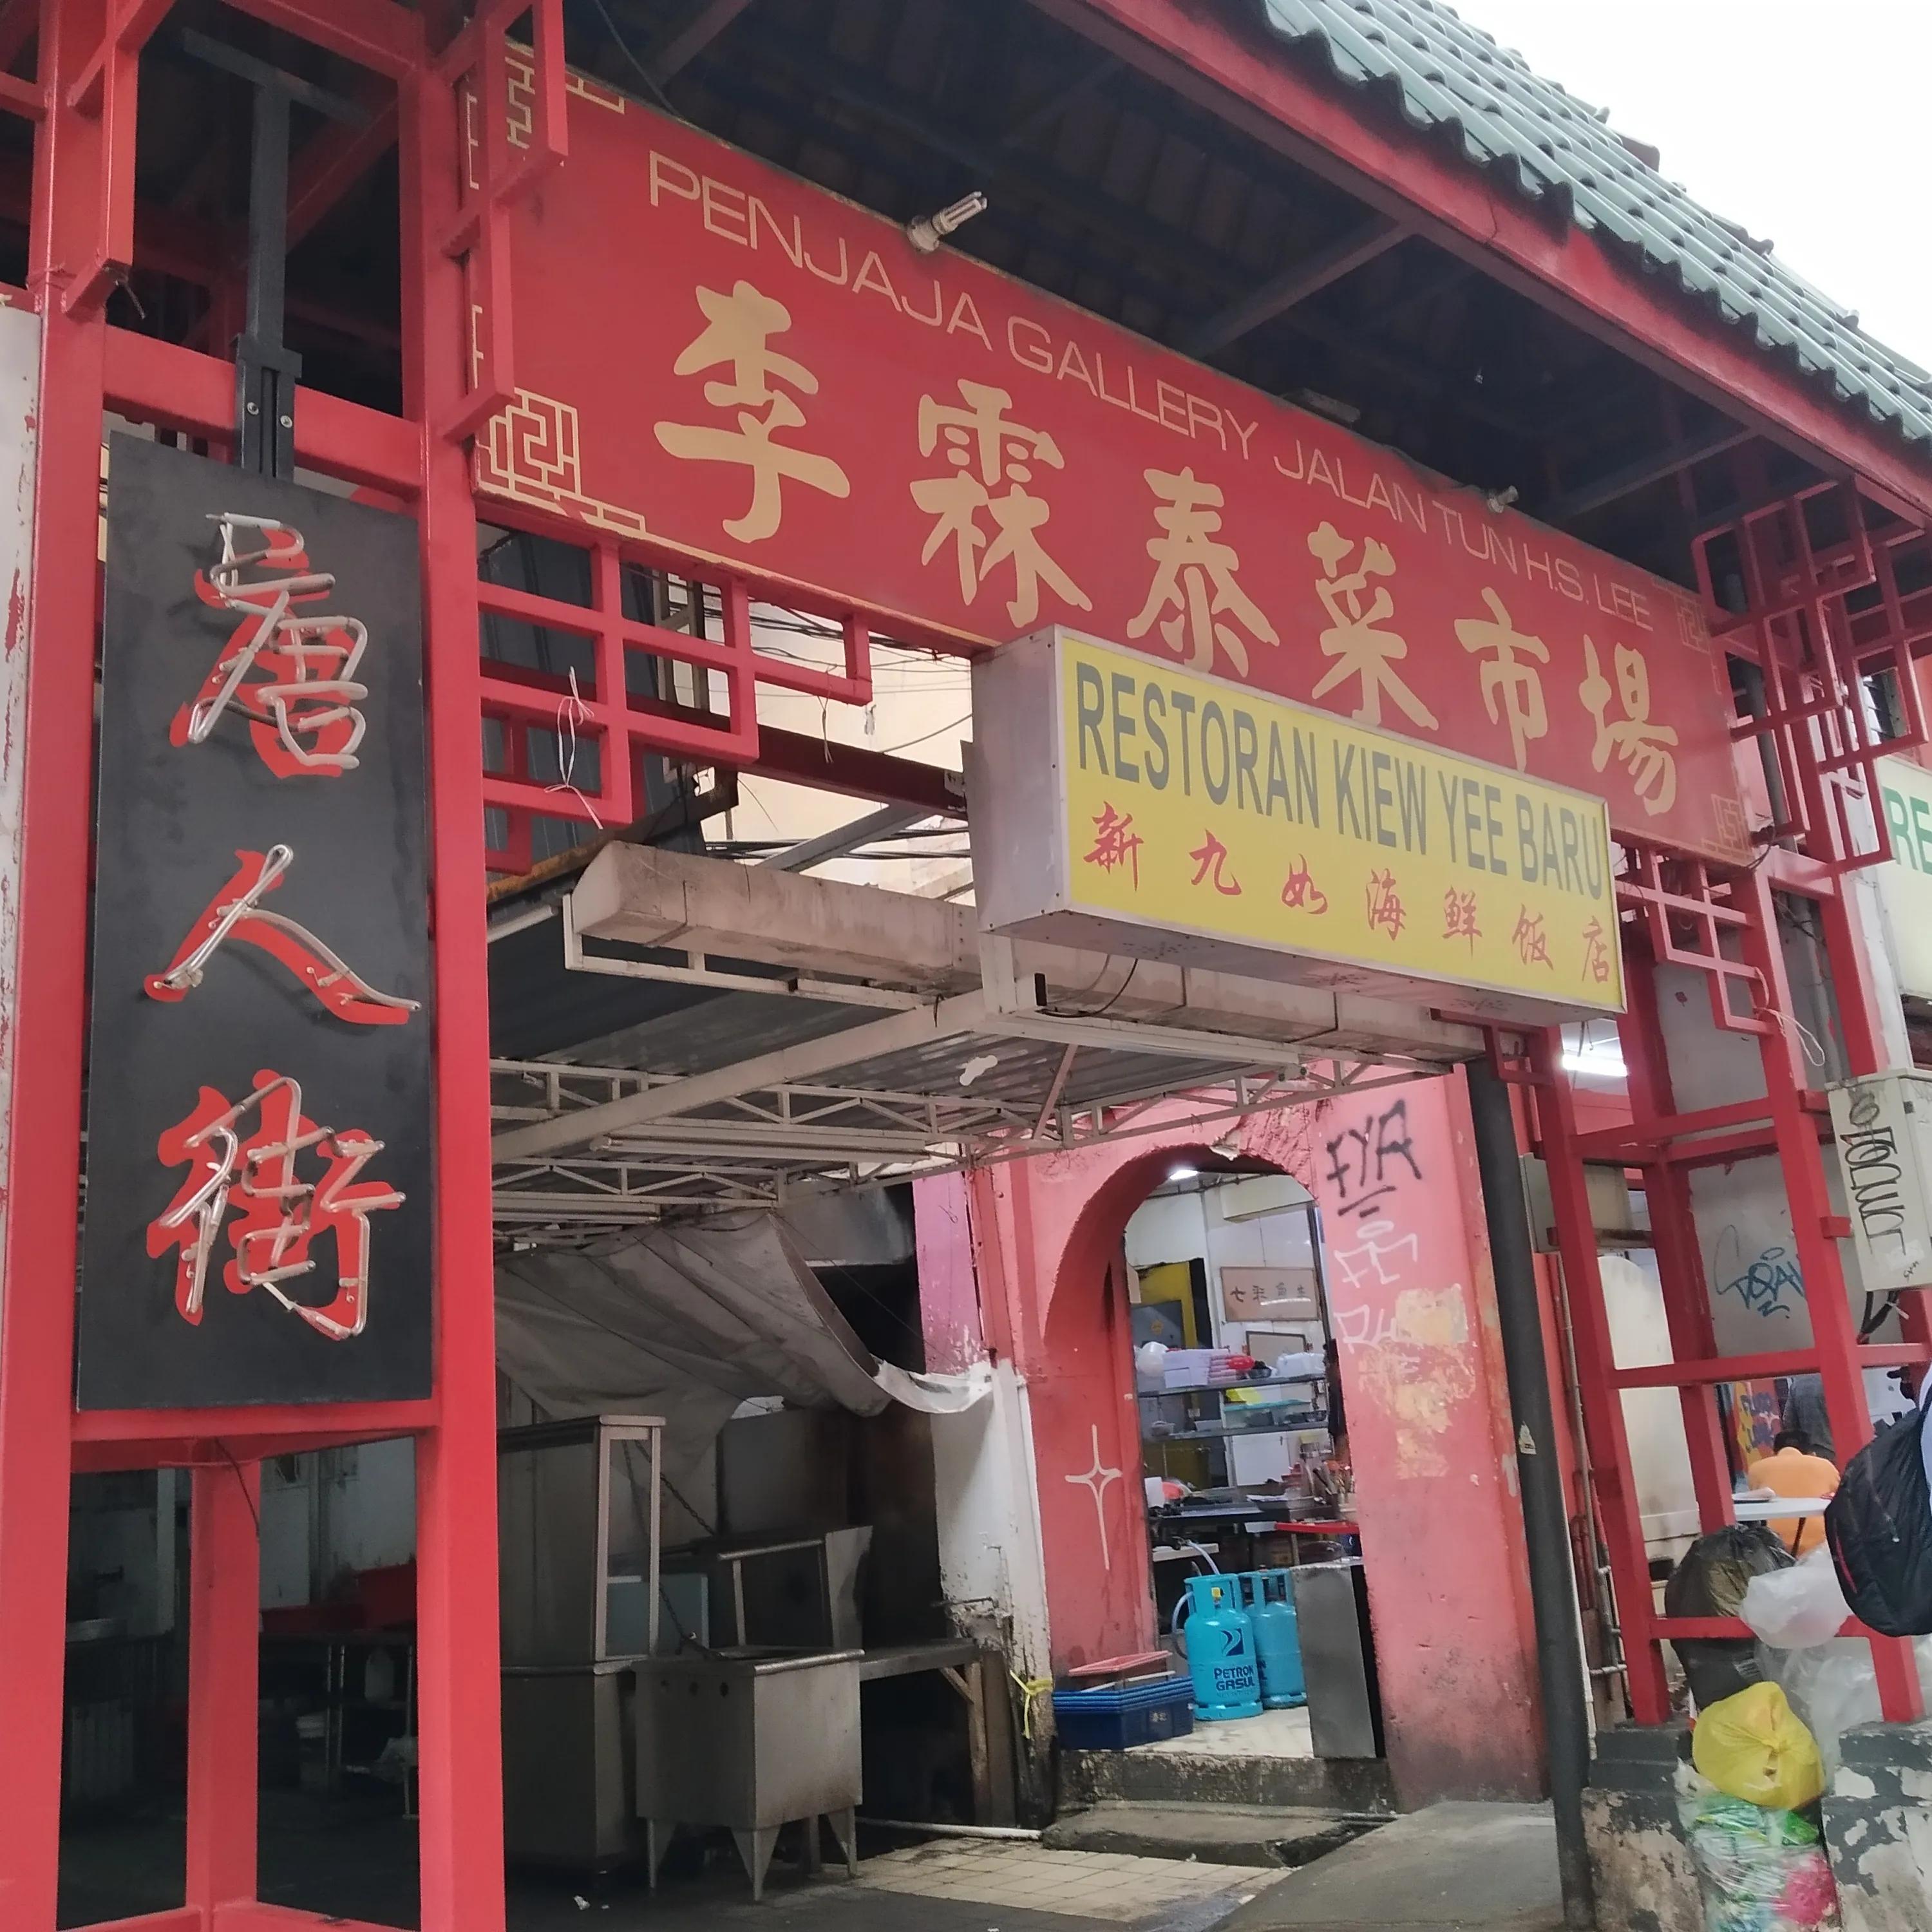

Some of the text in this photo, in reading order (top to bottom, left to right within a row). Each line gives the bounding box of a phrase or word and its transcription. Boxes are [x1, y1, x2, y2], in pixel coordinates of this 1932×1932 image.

[649, 150, 1654, 632] PENJAJA GALLERY JALAN TUN H.S. LEE
[654, 279, 1679, 817] 李霖泰菜市場
[144, 513, 421, 1341] 唐人街
[1076, 661, 1602, 900] RESTORAN KIEW YEE BARU
[1213, 1665, 1255, 1680] PETRON
[1215, 1676, 1256, 1692] GASUL
